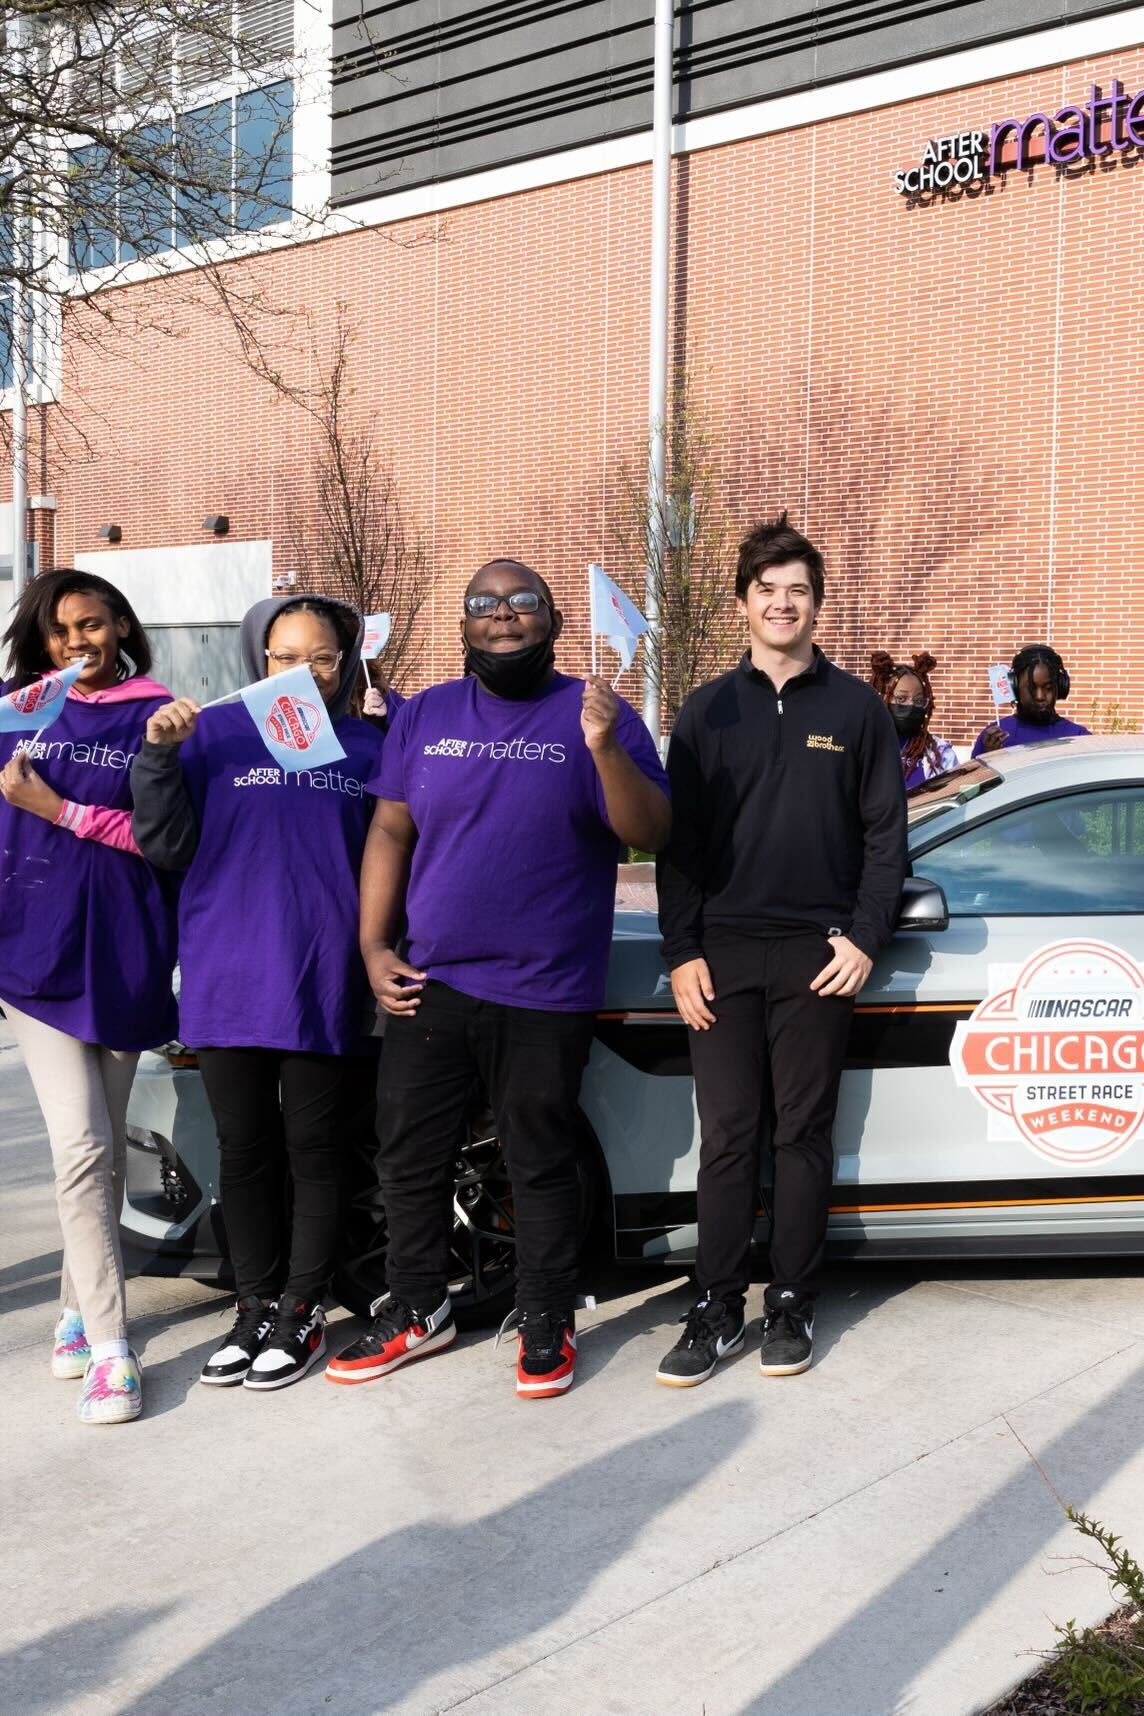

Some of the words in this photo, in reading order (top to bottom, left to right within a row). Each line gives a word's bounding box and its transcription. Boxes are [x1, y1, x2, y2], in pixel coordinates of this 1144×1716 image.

[921, 131, 984, 164] AFTER
[894, 157, 984, 194] SCHOOL
[281, 700, 306, 746] CHICAGO
[16, 739, 47, 752] AFER
[438, 738, 468, 749] AFTER
[808, 734, 833, 743] wood
[46, 741, 136, 769] matter
[424, 745, 464, 757] SCHOOL
[466, 737, 566, 763] matters
[233, 776, 282, 787] SCHOOL
[247, 768, 281, 777] AFTER
[284, 768, 368, 799] matter
[1052, 999, 1133, 1019] NASCAR
[1026, 1085, 1087, 1101] STREET
[1091, 1084, 1134, 1100] RACE
[1029, 1108, 1127, 1129] WEEKEND
